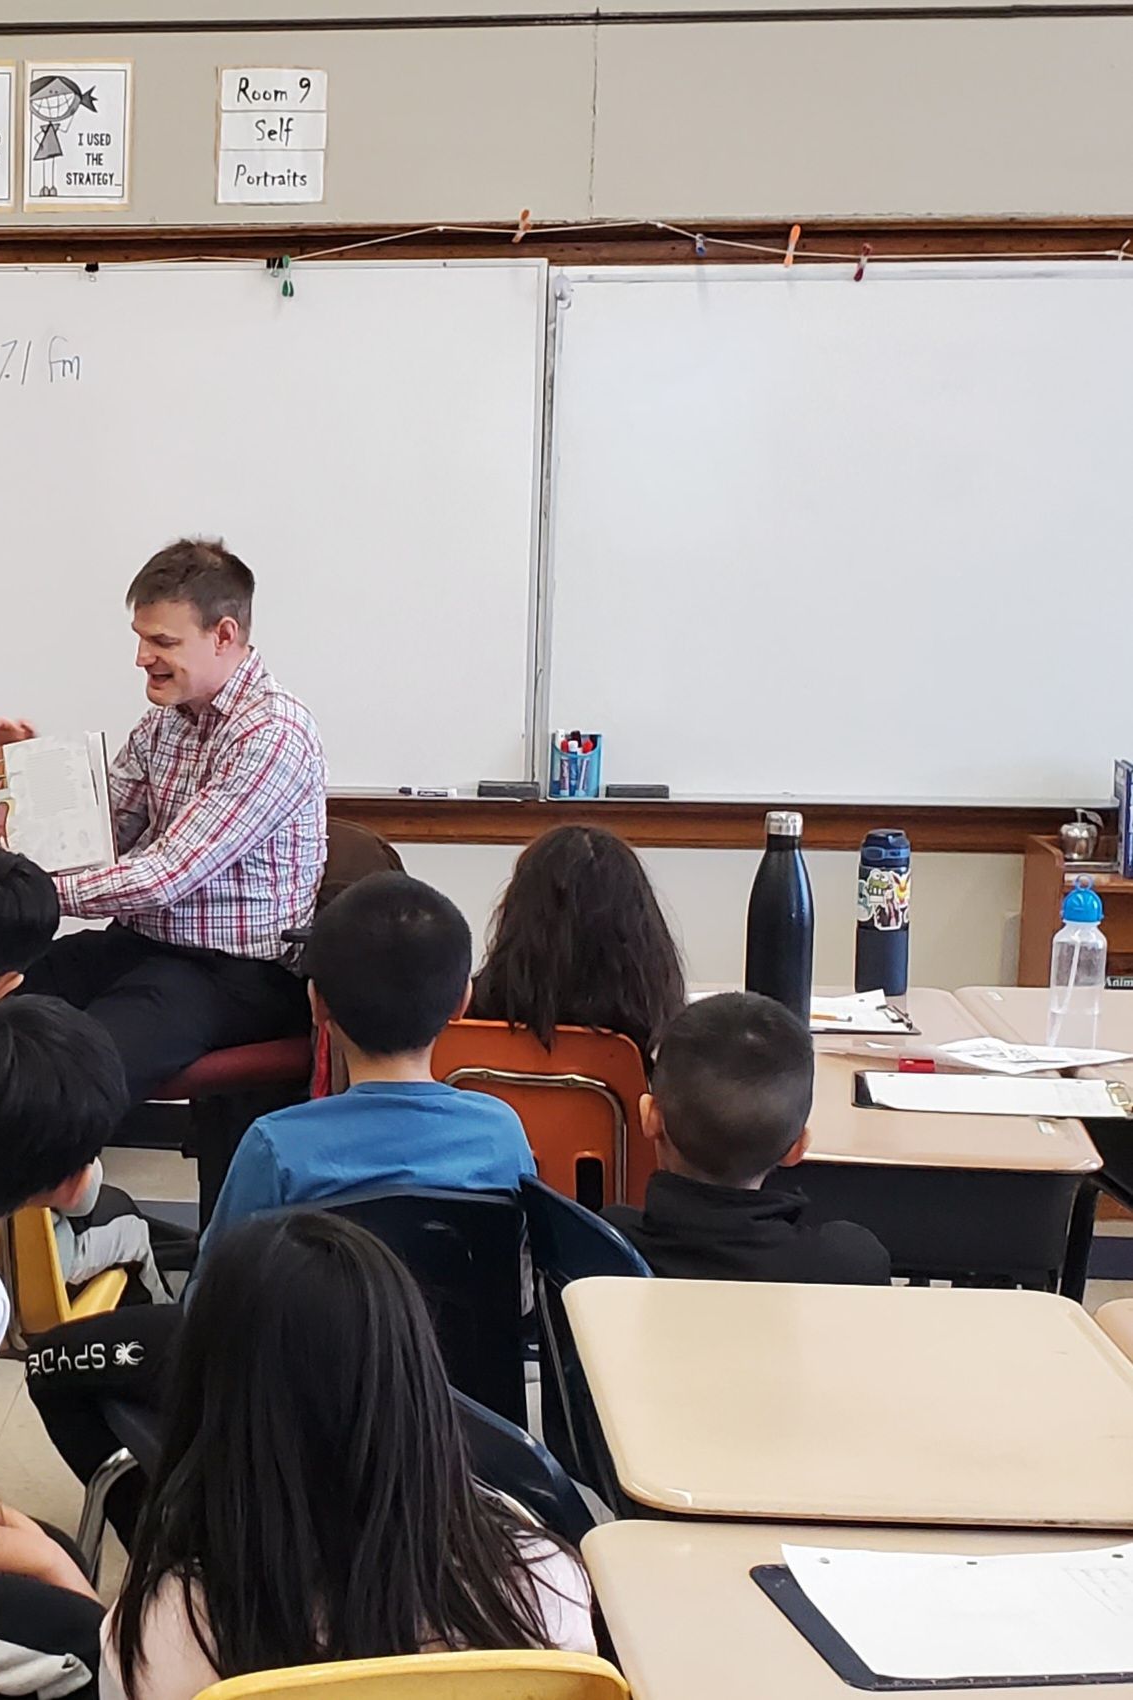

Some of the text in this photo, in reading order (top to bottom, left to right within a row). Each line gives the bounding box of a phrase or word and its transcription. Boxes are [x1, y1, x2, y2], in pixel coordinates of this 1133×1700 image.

[237, 77, 311, 104] Room 9
[78, 133, 112, 146] I USED
[255, 117, 294, 146] Self
[85, 152, 104, 166] THE
[234, 164, 307, 187] Portraits
